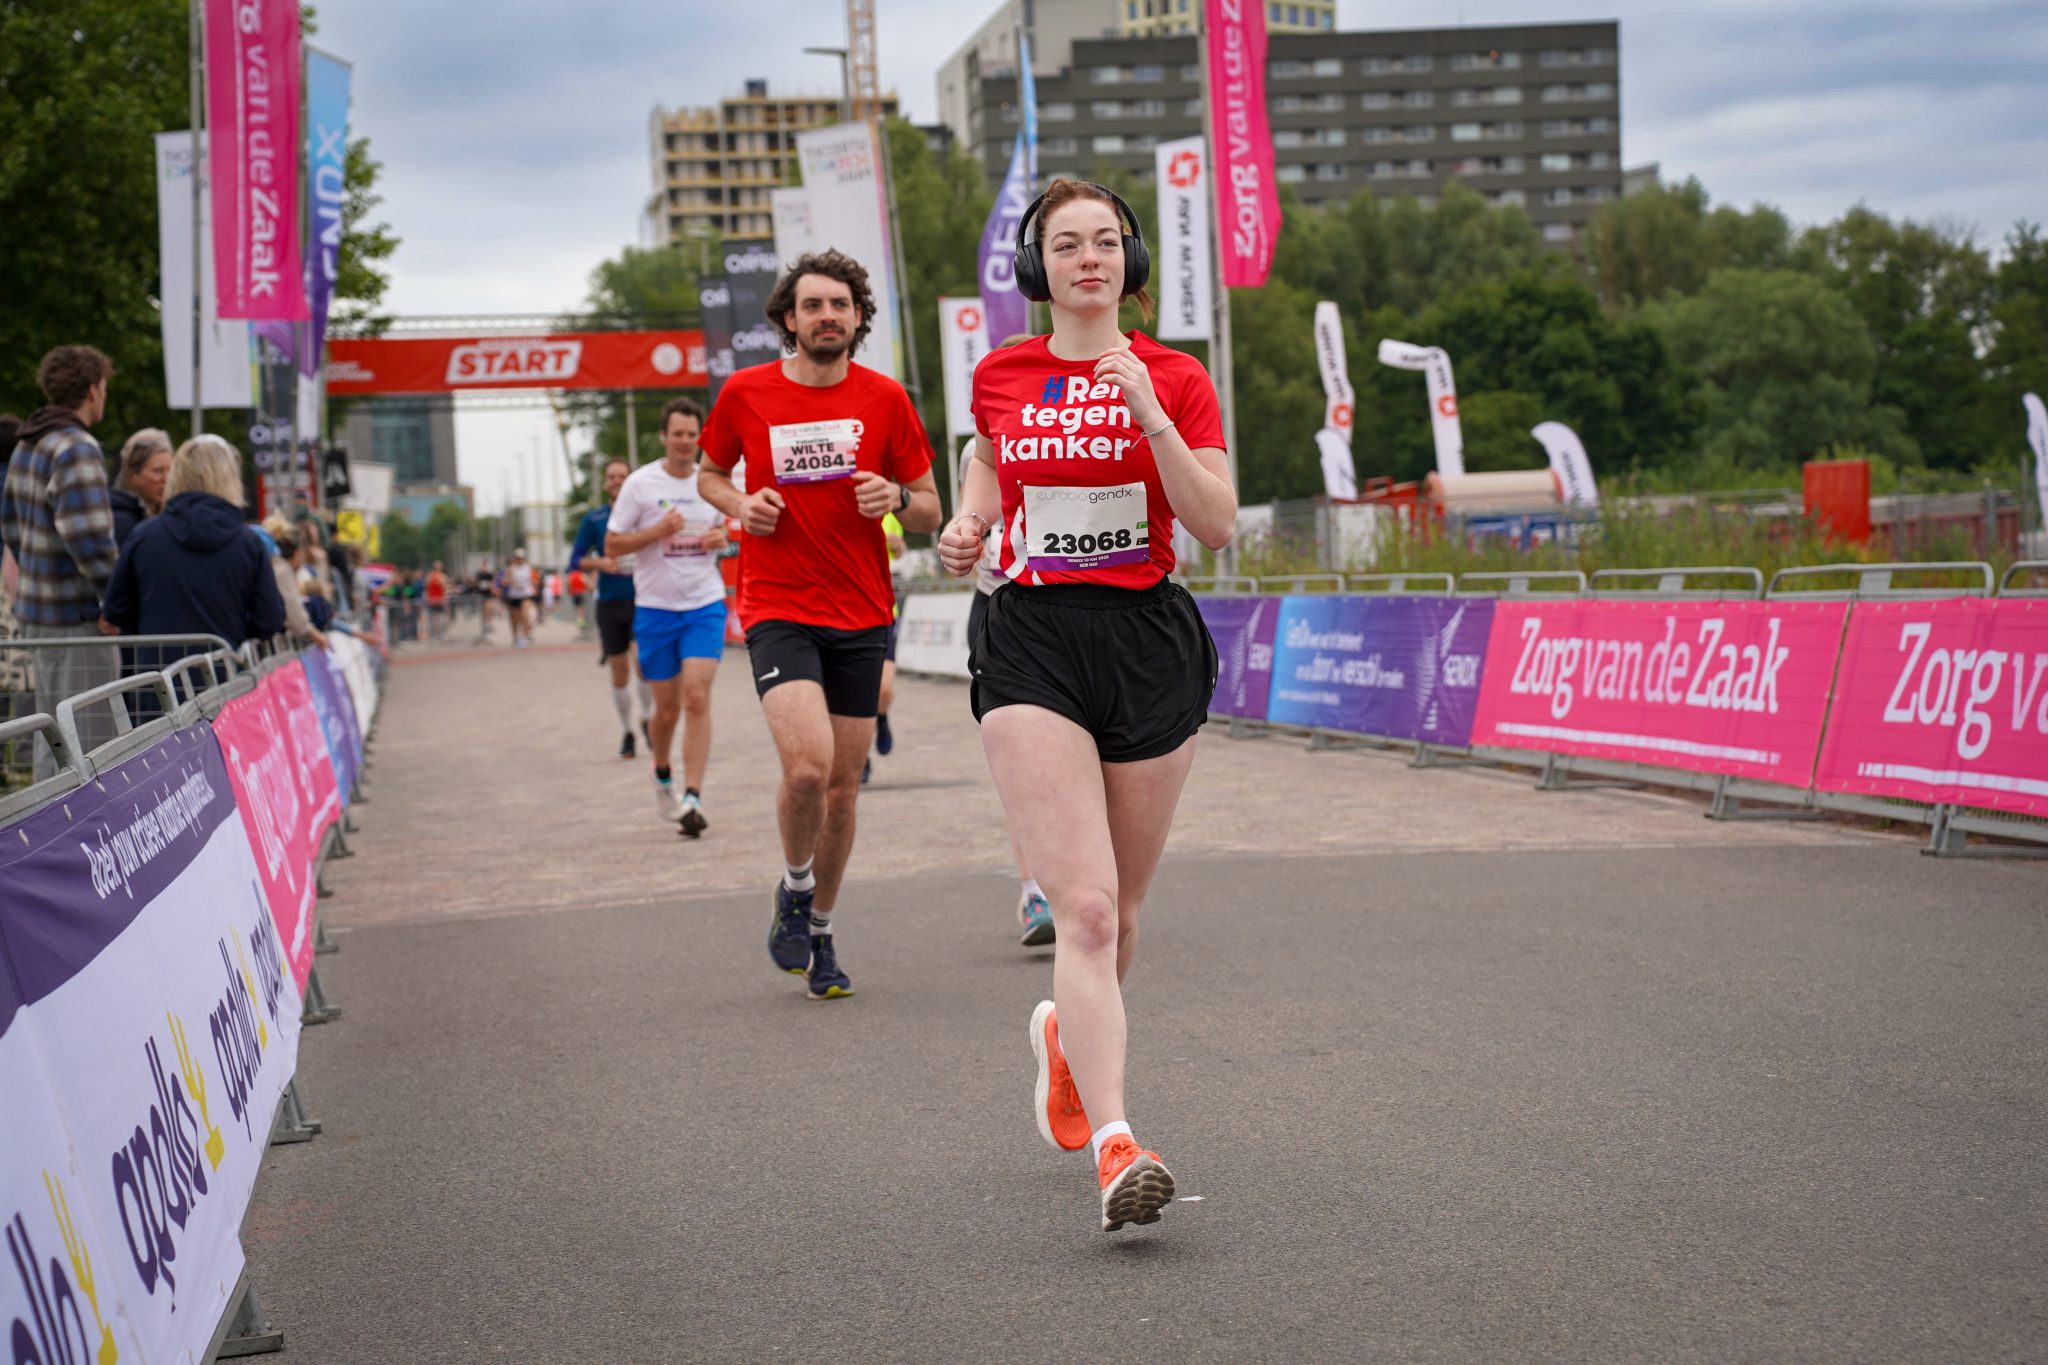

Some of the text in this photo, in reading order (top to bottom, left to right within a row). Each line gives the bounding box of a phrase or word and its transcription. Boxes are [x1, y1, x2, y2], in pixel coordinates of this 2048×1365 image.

[246, 44, 270, 124] van
[1222, 25, 1244, 77] de
[248, 126, 273, 186] de
[1226, 81, 1251, 160] van
[249, 186, 280, 300] Zaak
[1232, 162, 1260, 258] Zorg
[458, 349, 572, 376] START
[790, 442, 835, 456] WILTE
[1000, 434, 1131, 464] kanker
[1021, 403, 1131, 435] tegen
[784, 453, 845, 472] 24084
[1043, 528, 1132, 554] 23068
[1510, 616, 1789, 720] Zorg van de Zaak
[1883, 621, 2008, 760] Zorg
[80, 829, 122, 900] Boek
[104, 822, 141, 900] jouw
[129, 802, 167, 865] actieve
[209, 936, 263, 1143] apollo
[111, 1035, 208, 1315] apollo
